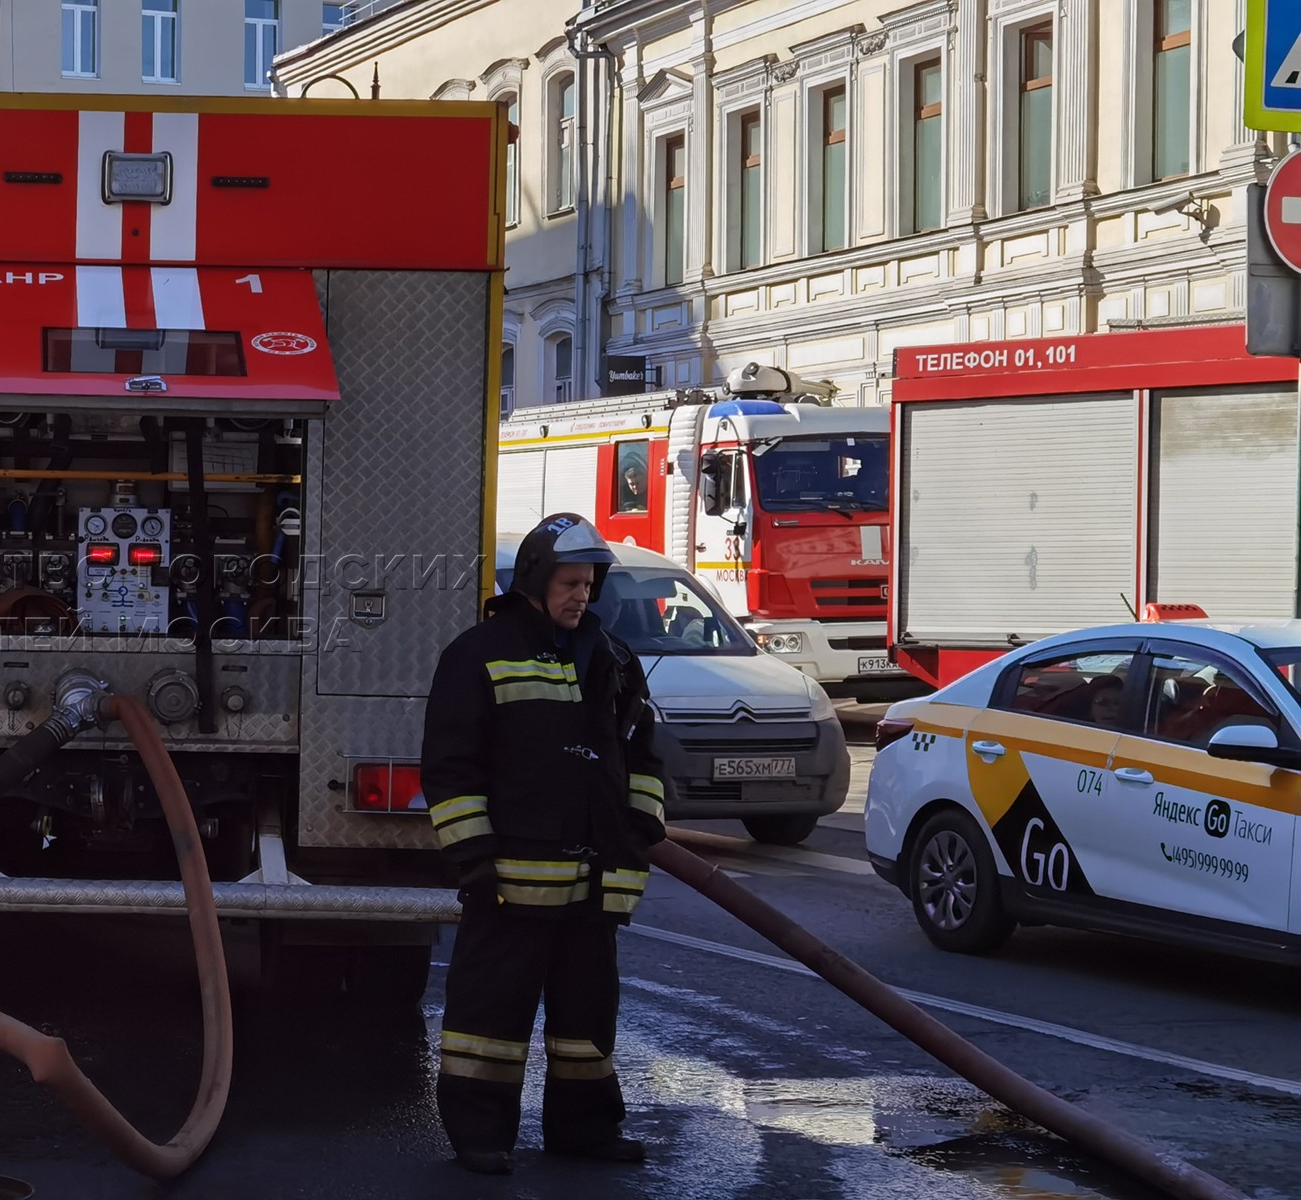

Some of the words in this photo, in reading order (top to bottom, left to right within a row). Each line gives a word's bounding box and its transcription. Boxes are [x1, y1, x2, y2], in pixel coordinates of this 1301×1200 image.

[235, 273, 264, 294] 1
[915, 349, 1008, 372] ТЕЛЕФОН
[1014, 348, 1042, 369] 01,
[1045, 344, 1077, 365] 101
[1077, 769, 1104, 797] 074
[1153, 791, 1202, 827] Яндекс
[1207, 803, 1228, 837] Go
[1233, 809, 1273, 846] Такси
[1020, 816, 1070, 892] Go
